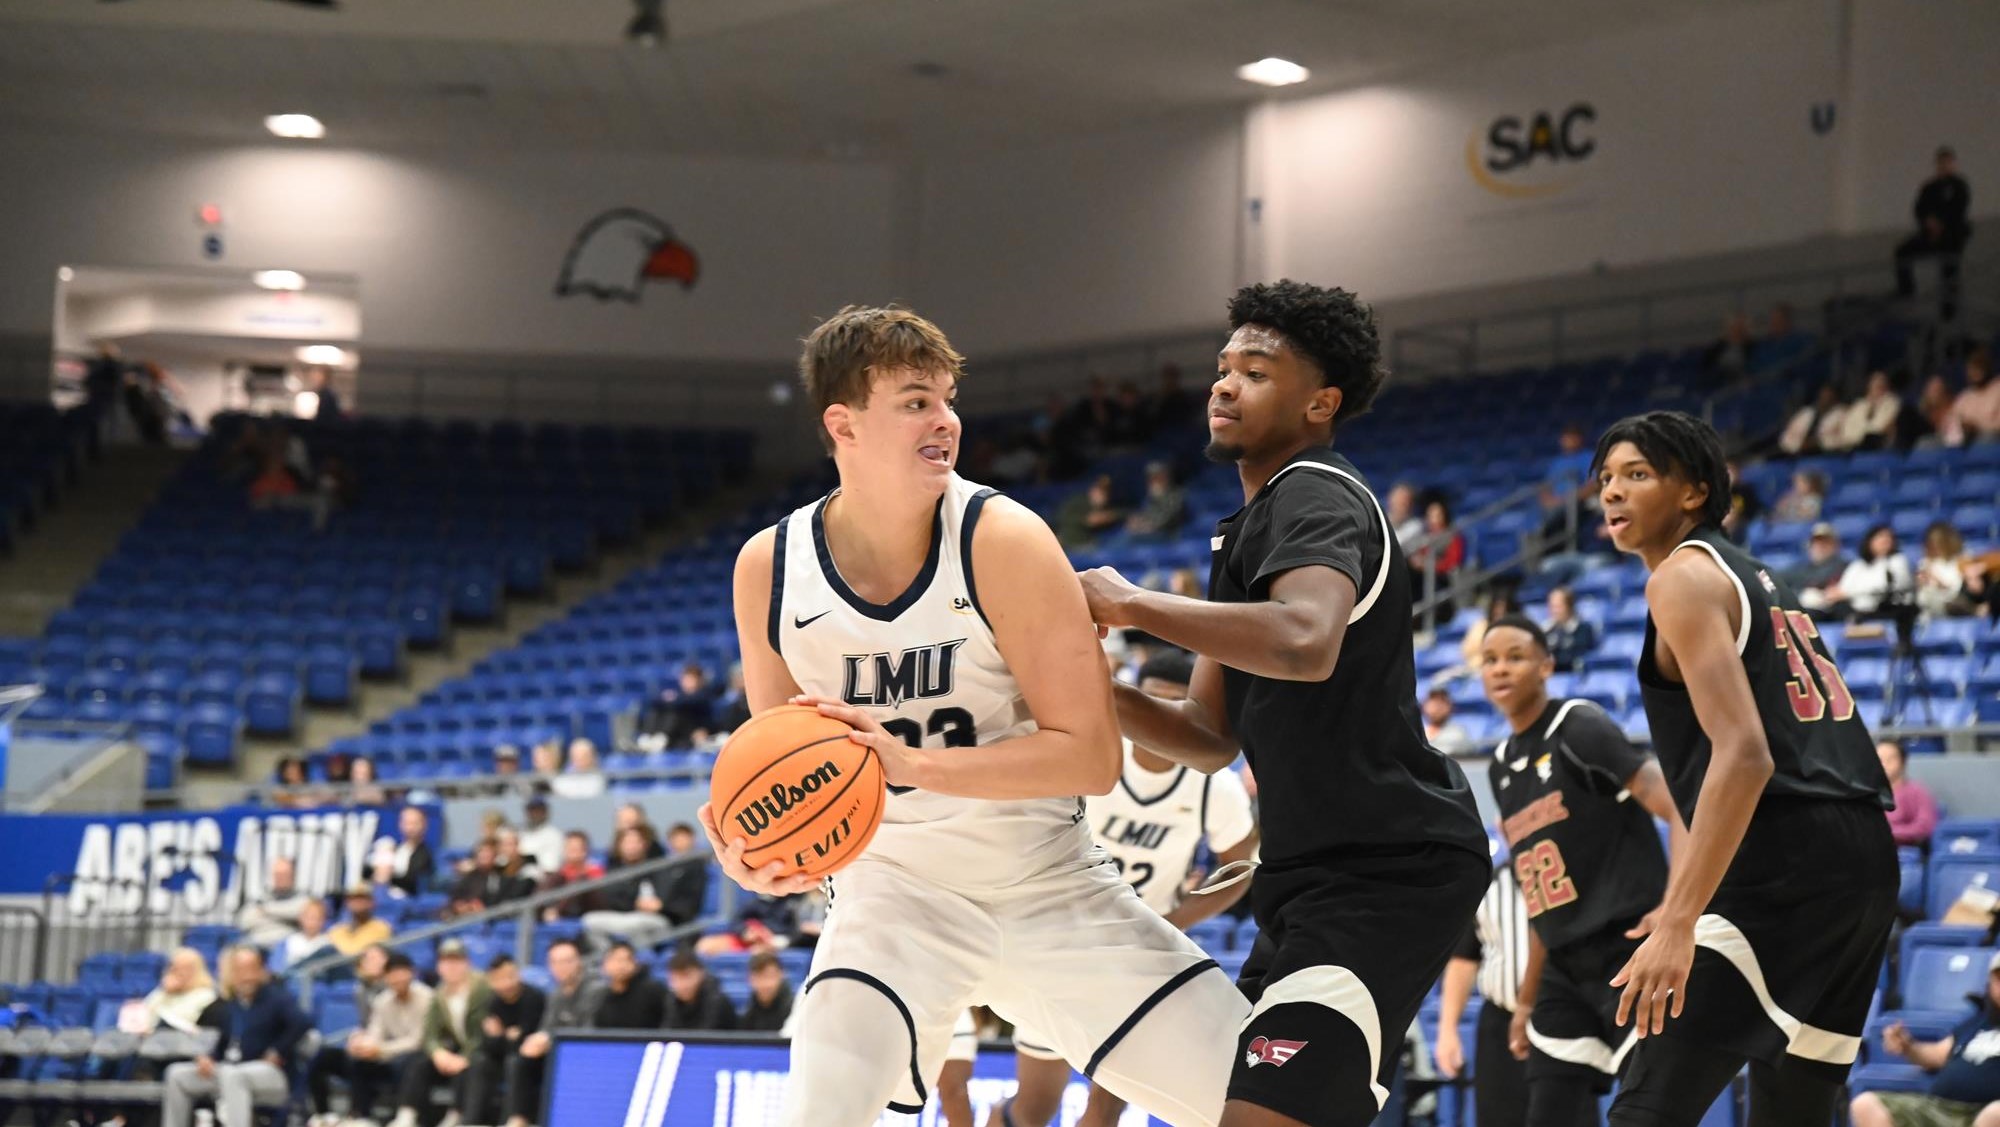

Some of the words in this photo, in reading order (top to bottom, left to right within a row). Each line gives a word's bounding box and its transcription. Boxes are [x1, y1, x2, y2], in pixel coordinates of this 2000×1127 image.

[1487, 103, 1597, 173] SAC
[841, 638, 968, 709] LMU
[1770, 606, 1855, 722] 35
[735, 760, 841, 836] Wilson
[1101, 814, 1173, 850] LMU
[70, 816, 222, 916] ABE'S
[226, 810, 380, 913] ARMY
[795, 817, 851, 867] EVO
[1515, 838, 1578, 919] 22
